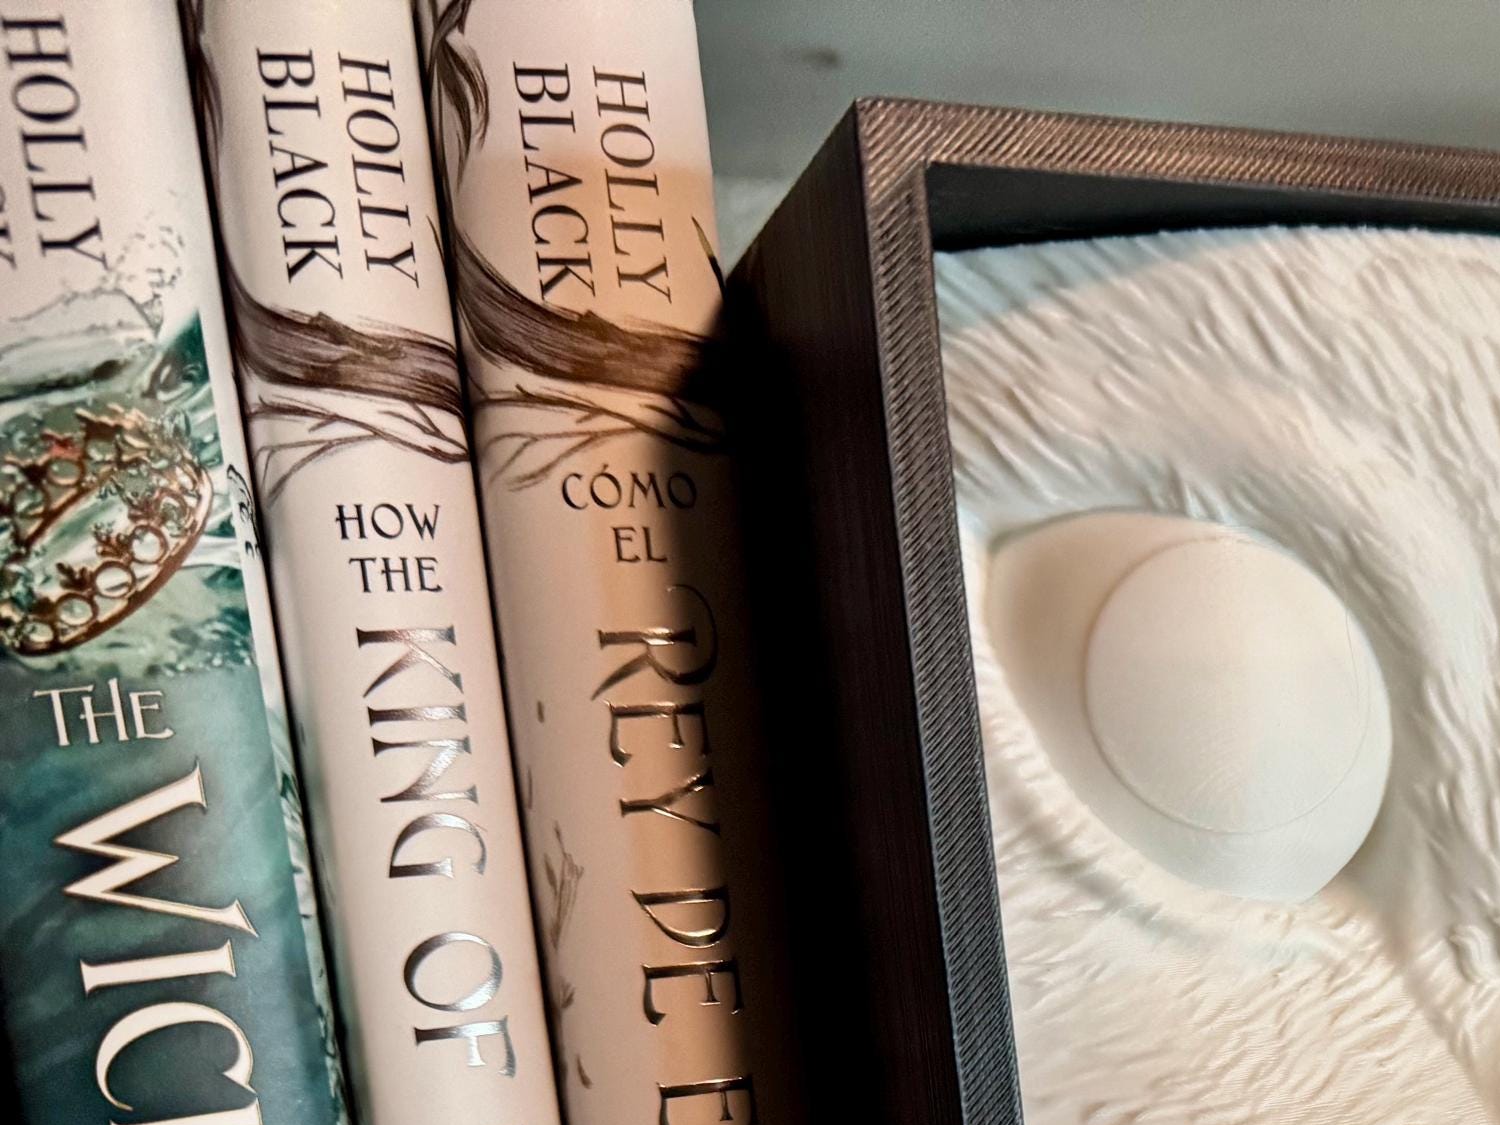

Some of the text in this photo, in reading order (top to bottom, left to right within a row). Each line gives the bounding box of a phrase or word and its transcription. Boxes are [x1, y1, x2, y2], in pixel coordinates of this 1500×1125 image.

[1, 15, 108, 270] HOLLY
[255, 47, 344, 284] BLACK
[338, 50, 419, 289] HOLLY
[512, 61, 596, 301] BLACK
[592, 64, 671, 303] HOLLY
[335, 503, 441, 541] HOW
[350, 555, 443, 593] THE
[561, 463, 697, 509] CÓMO
[611, 526, 668, 563] EL
[33, 677, 175, 747] THE
[356, 625, 488, 880] KING
[592, 583, 721, 838] REY
[403, 930, 517, 1078] OF
[629, 884, 744, 1027] DE
